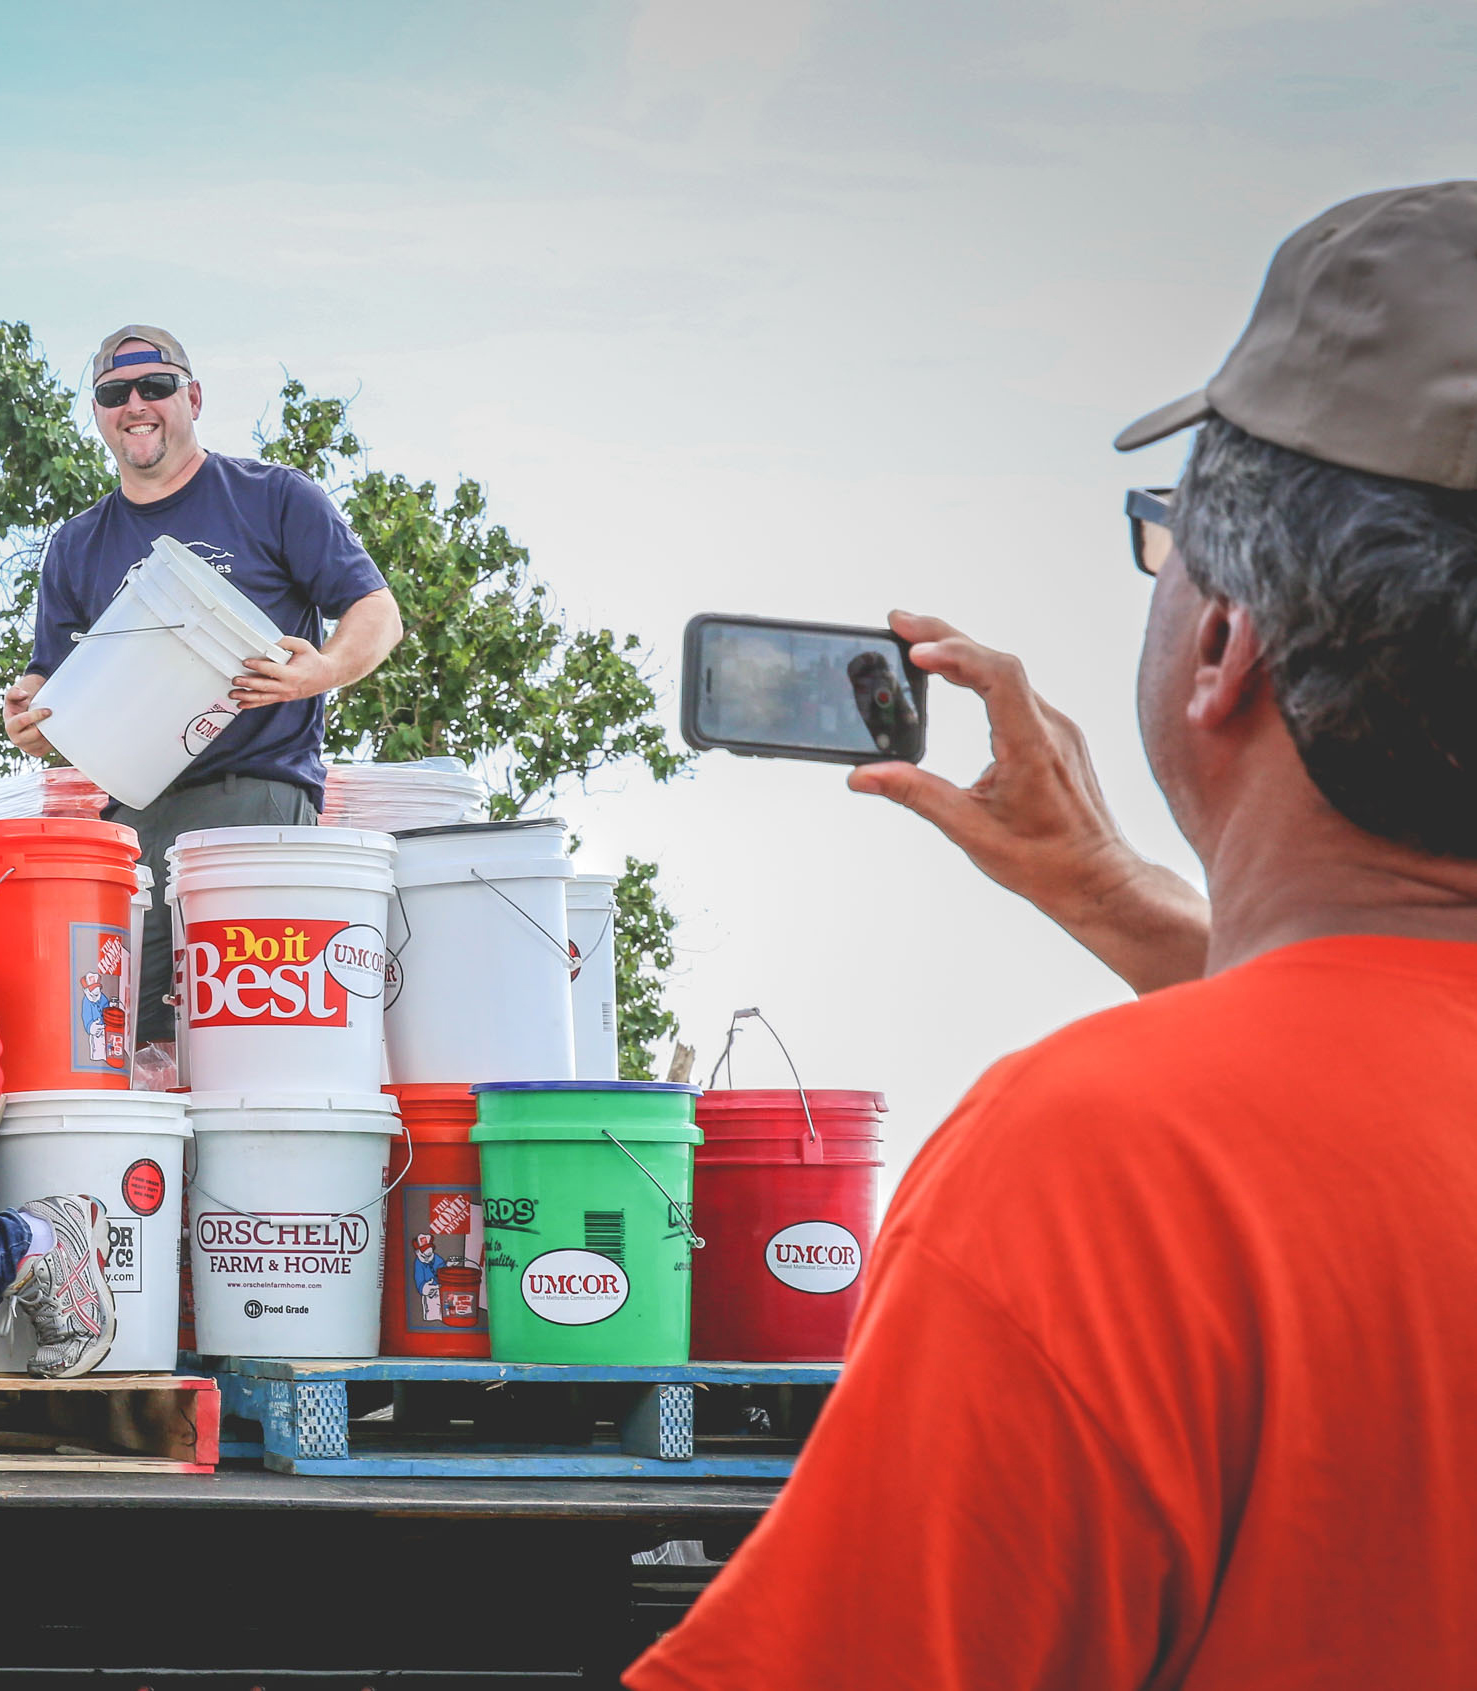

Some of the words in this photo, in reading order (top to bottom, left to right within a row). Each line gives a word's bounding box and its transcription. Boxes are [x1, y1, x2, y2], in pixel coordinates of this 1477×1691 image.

[223, 926, 280, 963] Do
[281, 926, 310, 962] it
[333, 943, 385, 974] UMCOR
[186, 941, 338, 1022] Best
[429, 1195, 470, 1235] HOME
[433, 1197, 451, 1215] THE
[444, 1208, 470, 1235] DEPOT
[200, 1219, 360, 1254] ORSCHELN
[209, 1255, 263, 1273] FARM
[268, 1259, 279, 1272] &
[284, 1256, 352, 1274] HOME
[774, 1243, 855, 1265] UMCOR
[528, 1274, 620, 1295] UMCOR
[264, 1304, 283, 1314] Food
[285, 1305, 309, 1314] Grade
